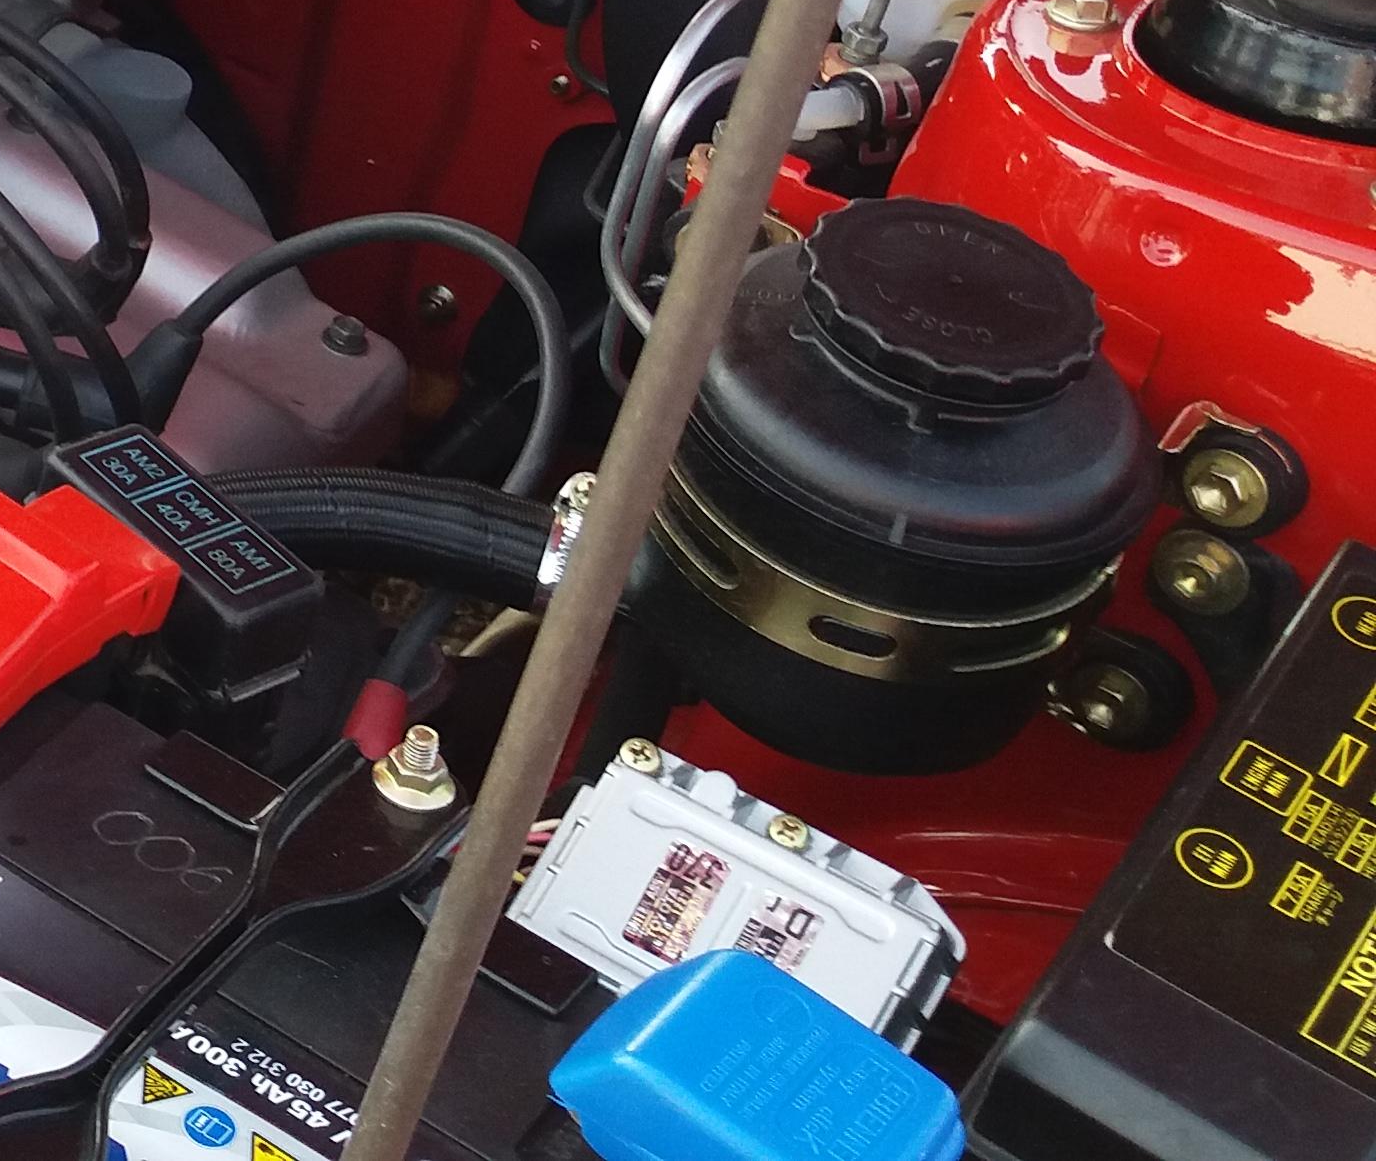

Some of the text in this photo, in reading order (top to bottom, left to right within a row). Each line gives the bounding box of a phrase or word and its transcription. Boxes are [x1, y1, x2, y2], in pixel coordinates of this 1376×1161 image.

[900, 305, 994, 343] CLOSE
[101, 455, 139, 487] 30A
[123, 447, 167, 480] AM2
[155, 502, 193, 533] 40A
[174, 490, 222, 527] CMH
[207, 548, 247, 581] 80A
[229, 539, 274, 571] AM1
[1240, 754, 1275, 791] ENGINE
[1262, 770, 1291, 799] MAIN
[1192, 842, 1217, 864] EFI
[1208, 848, 1238, 880] MAIN
[645, 884, 681, 939] TOYOTA
[1299, 881, 1335, 923] CHARGE
[230, 1037, 250, 1053] 2
[247, 1048, 287, 1077] 312
[284, 1072, 327, 1103] 030
